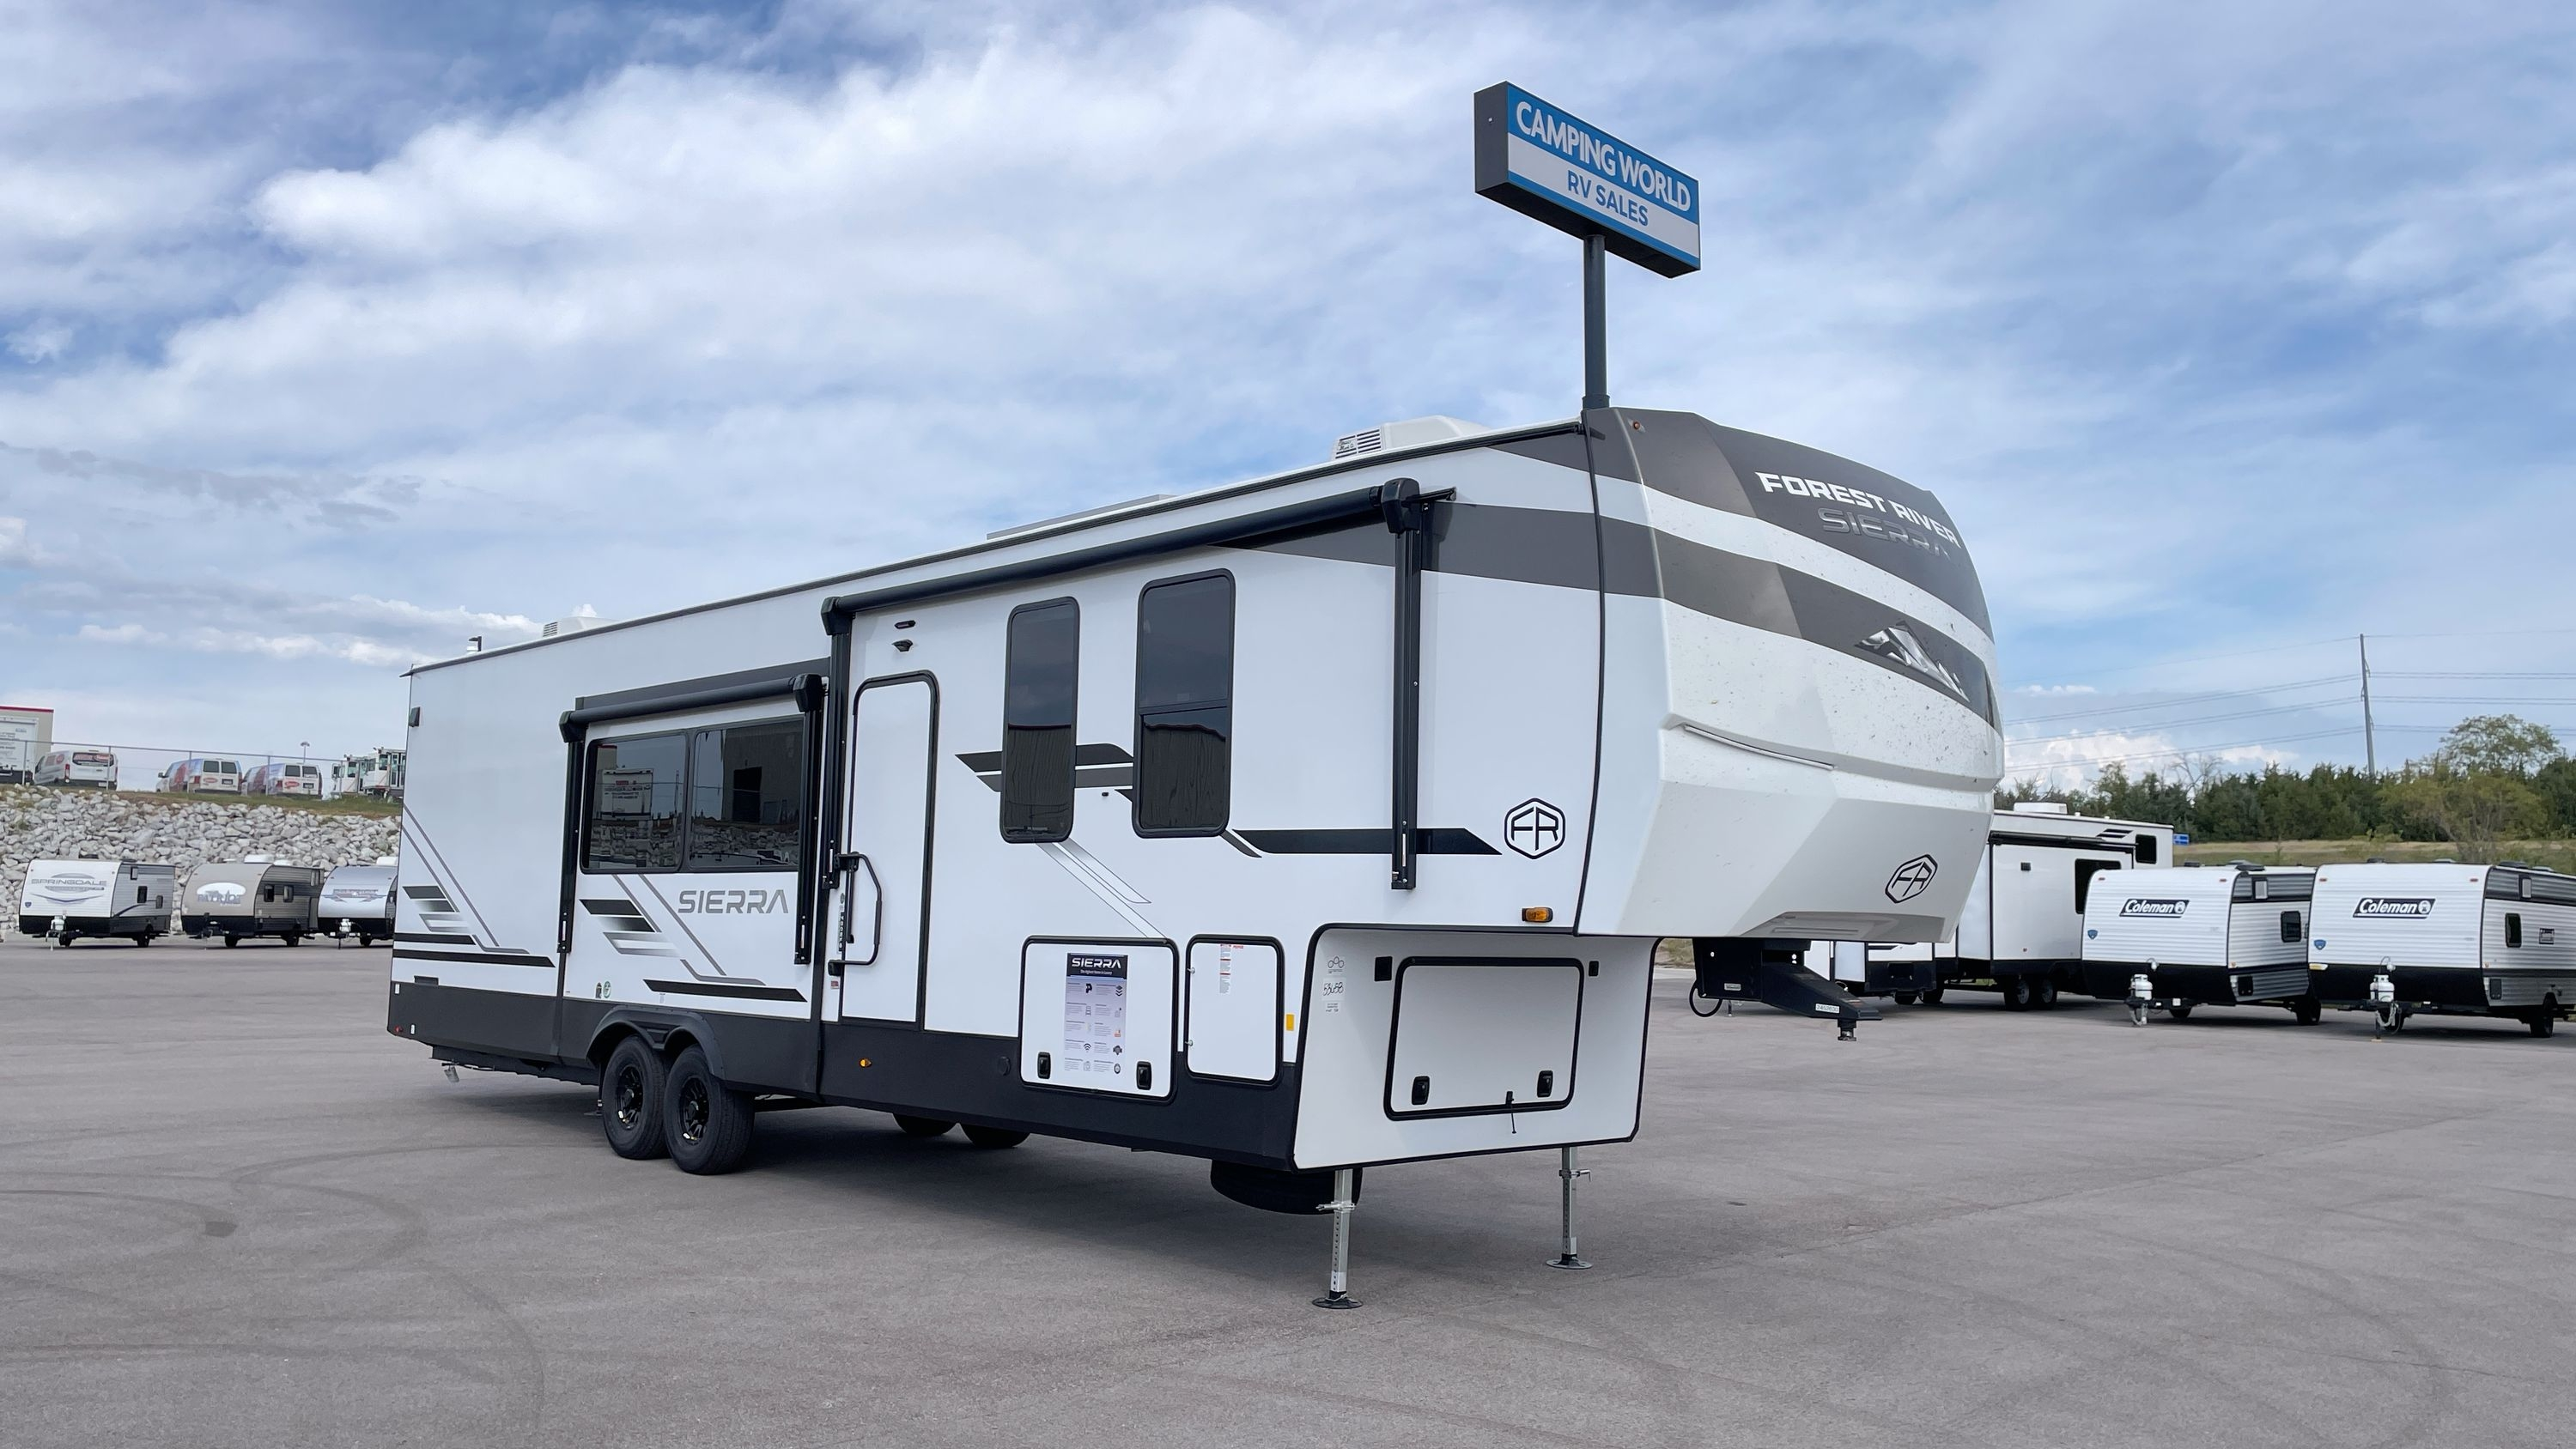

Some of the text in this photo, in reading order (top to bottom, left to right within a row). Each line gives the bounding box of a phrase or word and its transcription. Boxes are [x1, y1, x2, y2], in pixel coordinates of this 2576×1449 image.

[1516, 101, 1692, 212] CAMPING WORLD
[1567, 169, 1649, 227] RV SALES
[1754, 471, 1962, 549] FOREST RIVER
[1817, 507, 1951, 561] SIERRA
[677, 889, 789, 914] SIERRA
[2125, 899, 2174, 913] Coleman
[2359, 899, 2418, 914] Coleman
[1071, 957, 1121, 969] SIERRA
